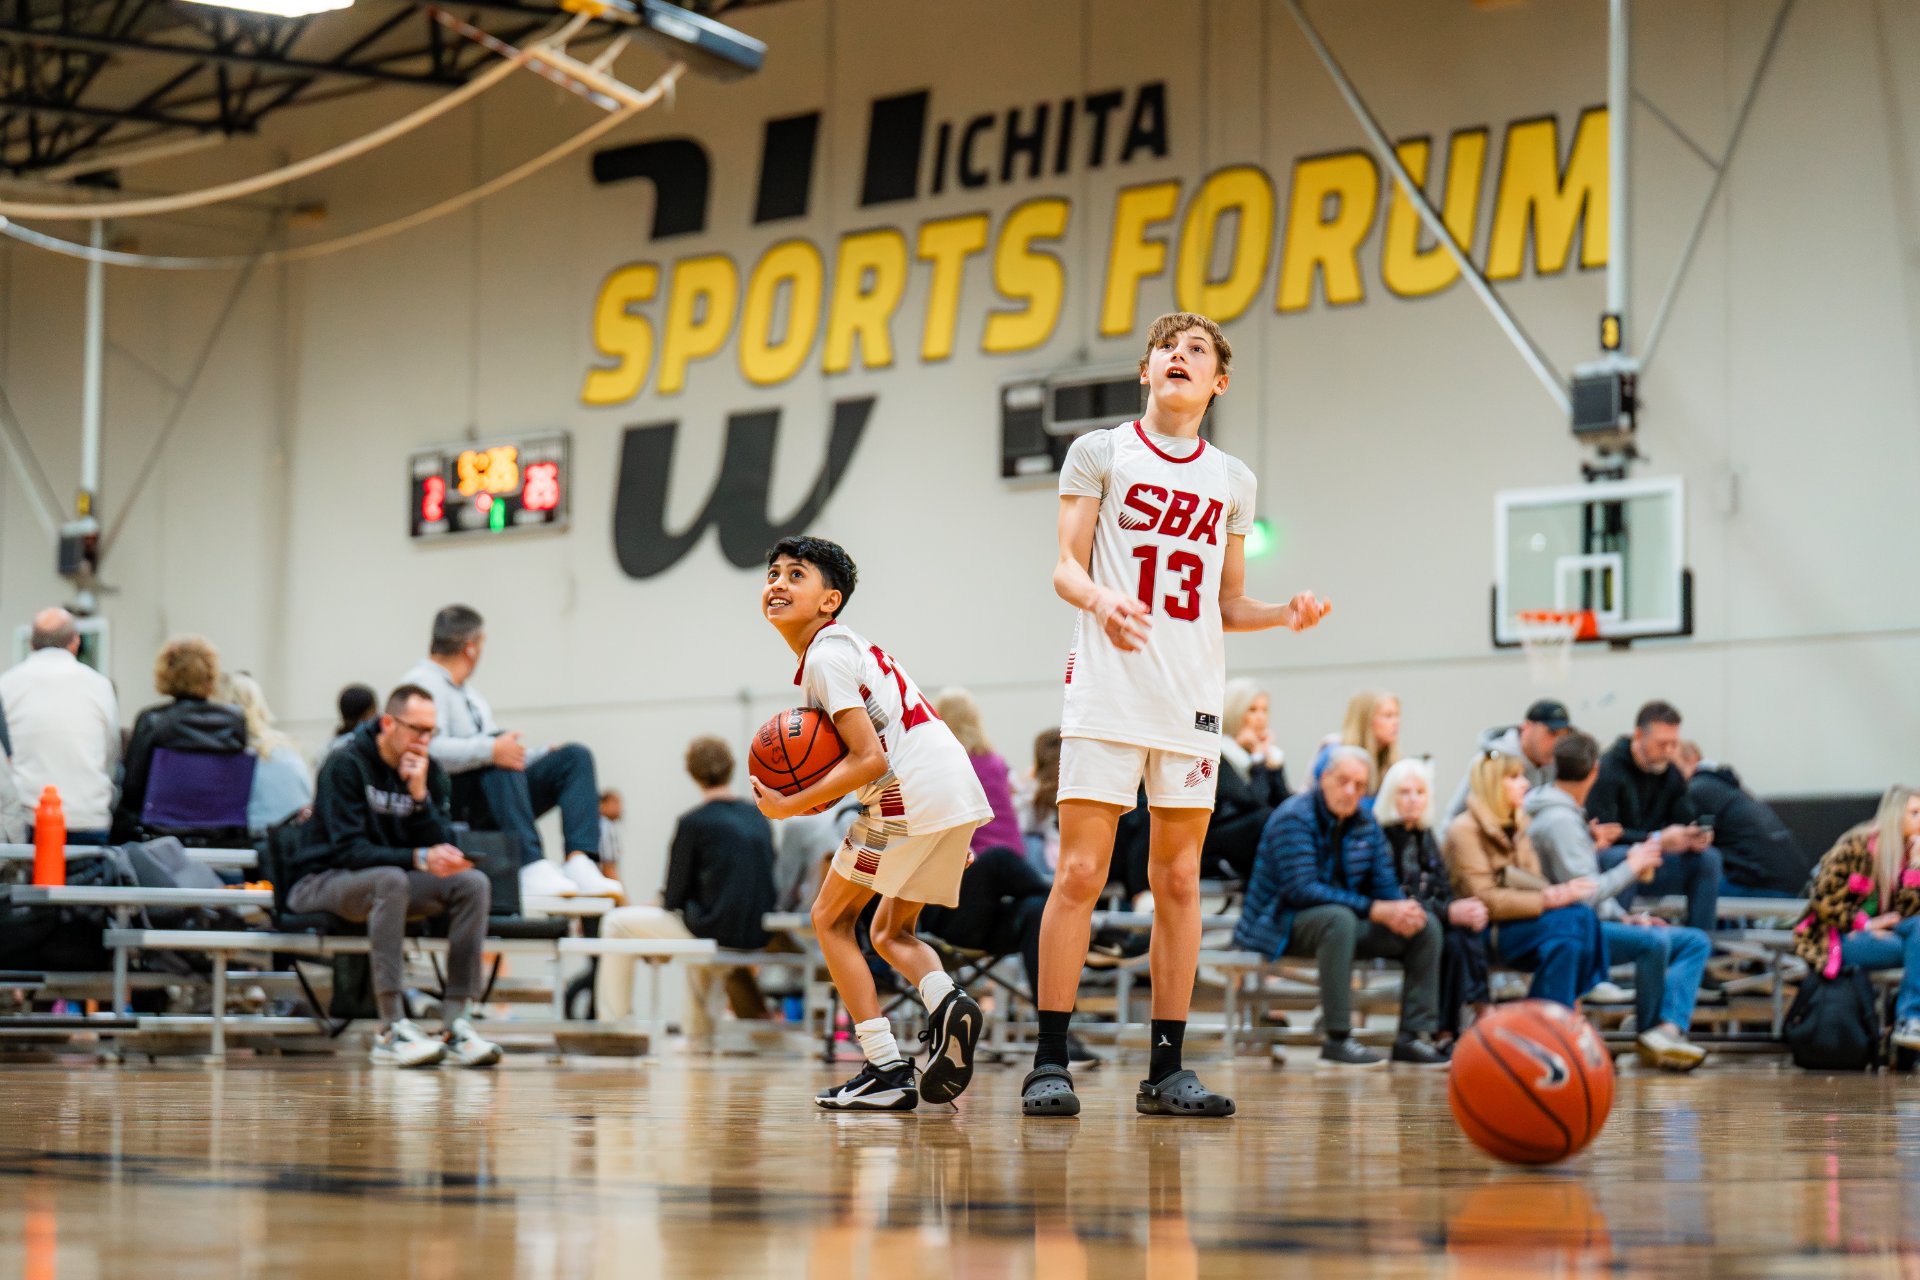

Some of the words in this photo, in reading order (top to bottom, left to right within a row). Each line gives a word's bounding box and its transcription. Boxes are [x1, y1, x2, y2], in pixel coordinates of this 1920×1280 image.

[580, 194, 1073, 407] SPORTS
[1099, 104, 1609, 340] FORUM
[1118, 482, 1224, 546] SBA
[1131, 544, 1205, 623] 13
